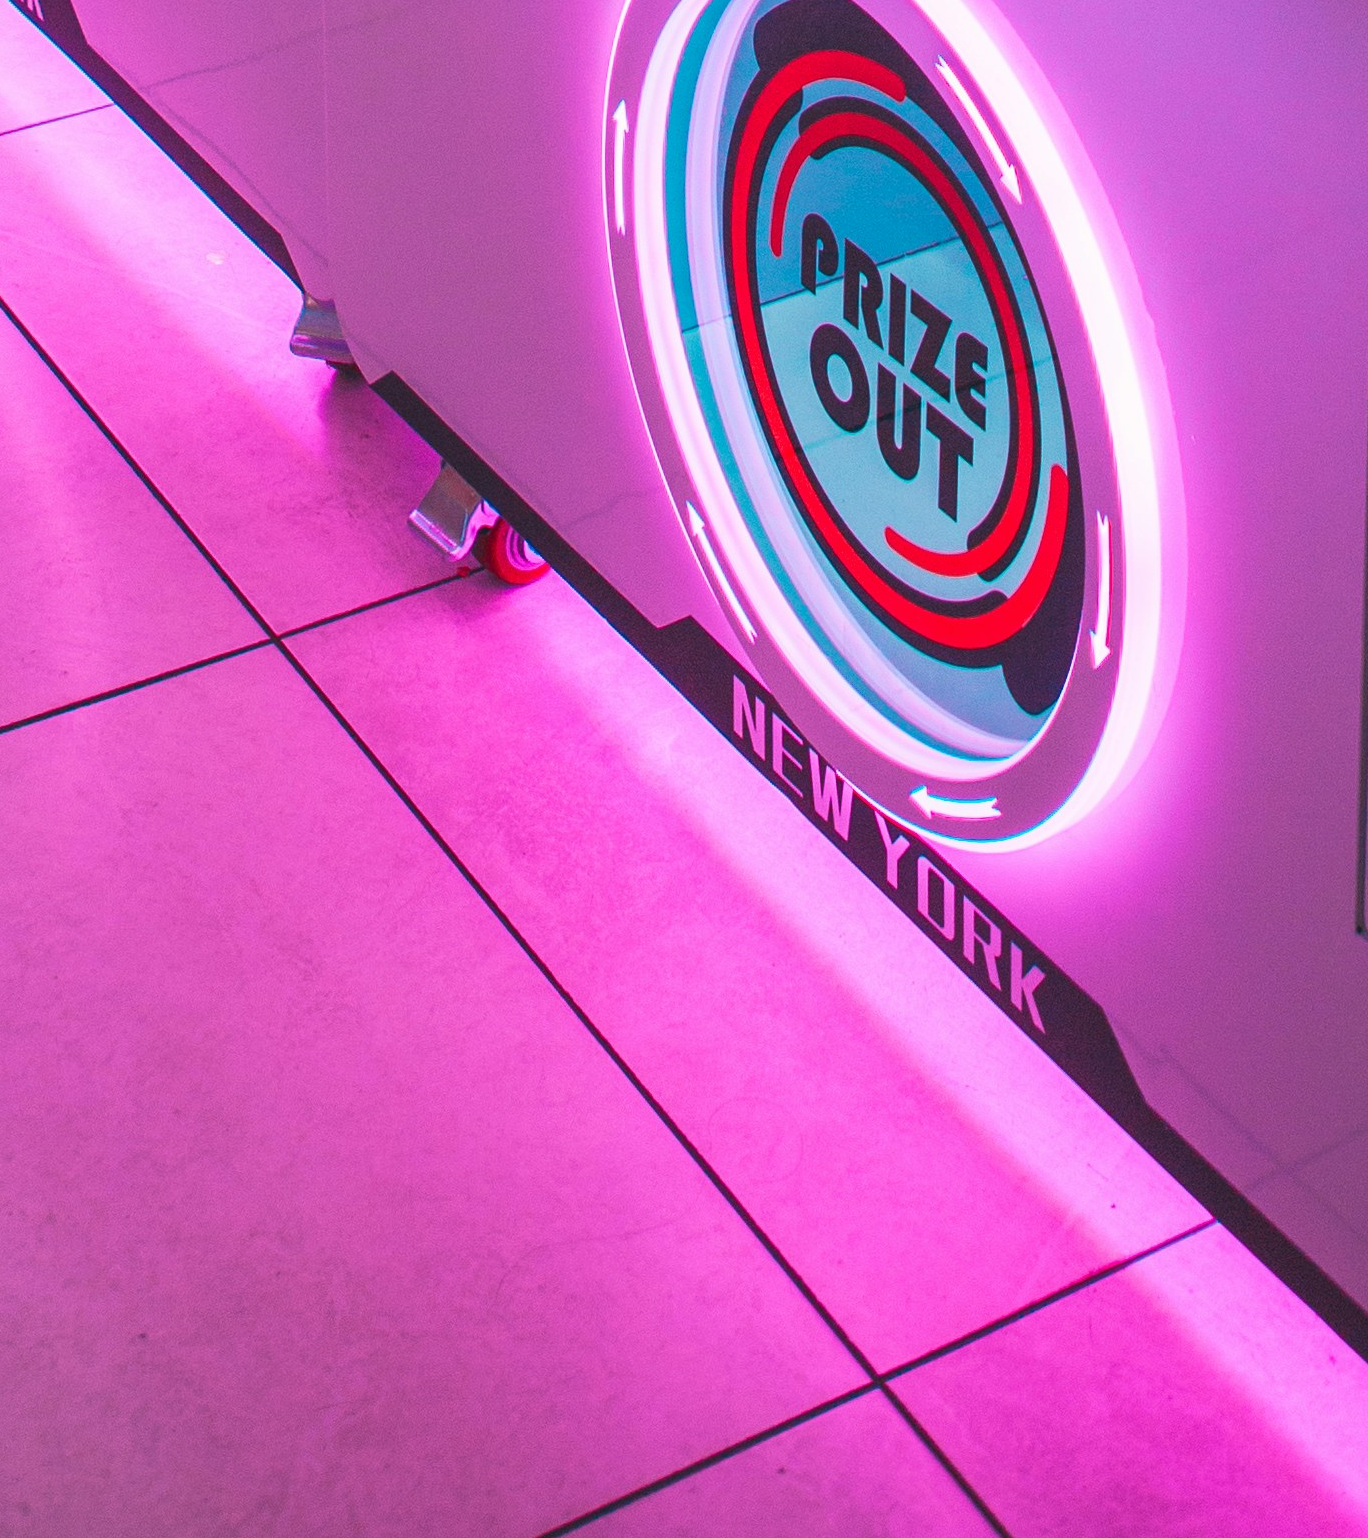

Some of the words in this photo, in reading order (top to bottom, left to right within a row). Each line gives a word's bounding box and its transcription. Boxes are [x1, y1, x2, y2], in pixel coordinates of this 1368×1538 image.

[799, 212, 989, 434] PRIZE
[807, 322, 974, 524] OUT
[731, 671, 853, 844] NEW
[879, 823, 1048, 1037] YORK
